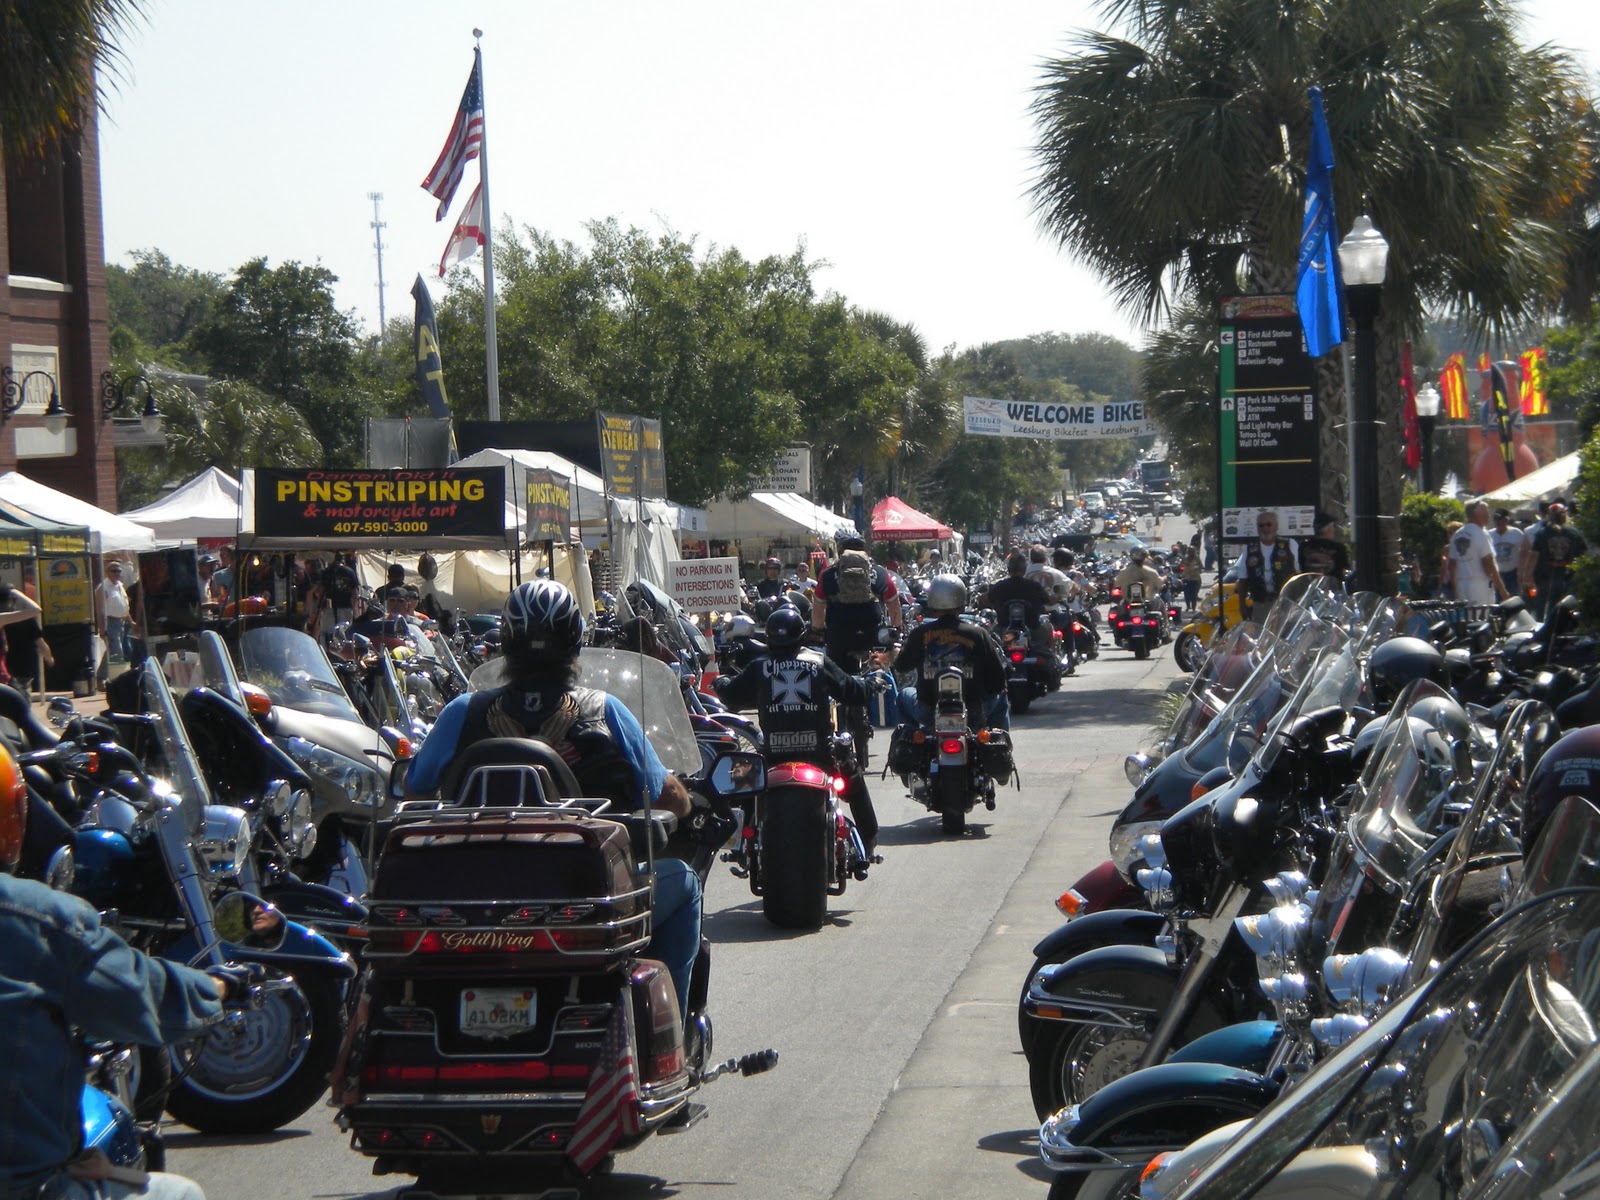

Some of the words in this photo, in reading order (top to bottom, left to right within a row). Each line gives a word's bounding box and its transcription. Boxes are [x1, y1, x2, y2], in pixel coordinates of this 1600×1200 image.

[1248, 348, 1260, 356] ATM
[1267, 357, 1283, 365] Stage
[1247, 396, 1260, 404] Park
[1007, 403, 1094, 424] WELCOME
[1248, 413, 1260, 421] ATM
[1013, 425, 1051, 437] Leesburg
[1054, 427, 1088, 436] Bikefest
[1239, 422, 1250, 430] Bud
[1257, 431, 1271, 439] Expo
[1240, 439, 1252, 447] Wall
[306, 472, 386, 480] Darren
[395, 471, 435, 480] Did
[278, 479, 485, 502] PINSTRIPING
[303, 503, 320, 517] &
[325, 502, 426, 522] motorcycle
[429, 502, 458, 517] art
[333, 521, 428, 533] 407-590-3000
[675, 566, 688, 576] NO
[690, 564, 723, 576] PARKING
[724, 564, 733, 574] IN
[675, 579, 735, 592] INTERSECTIONS
[686, 594, 739, 607] CROSSWALKS
[762, 659, 818, 678] Choppers
[783, 702, 801, 713] you
[803, 702, 818, 711] die
[769, 731, 818, 748] bigdog
